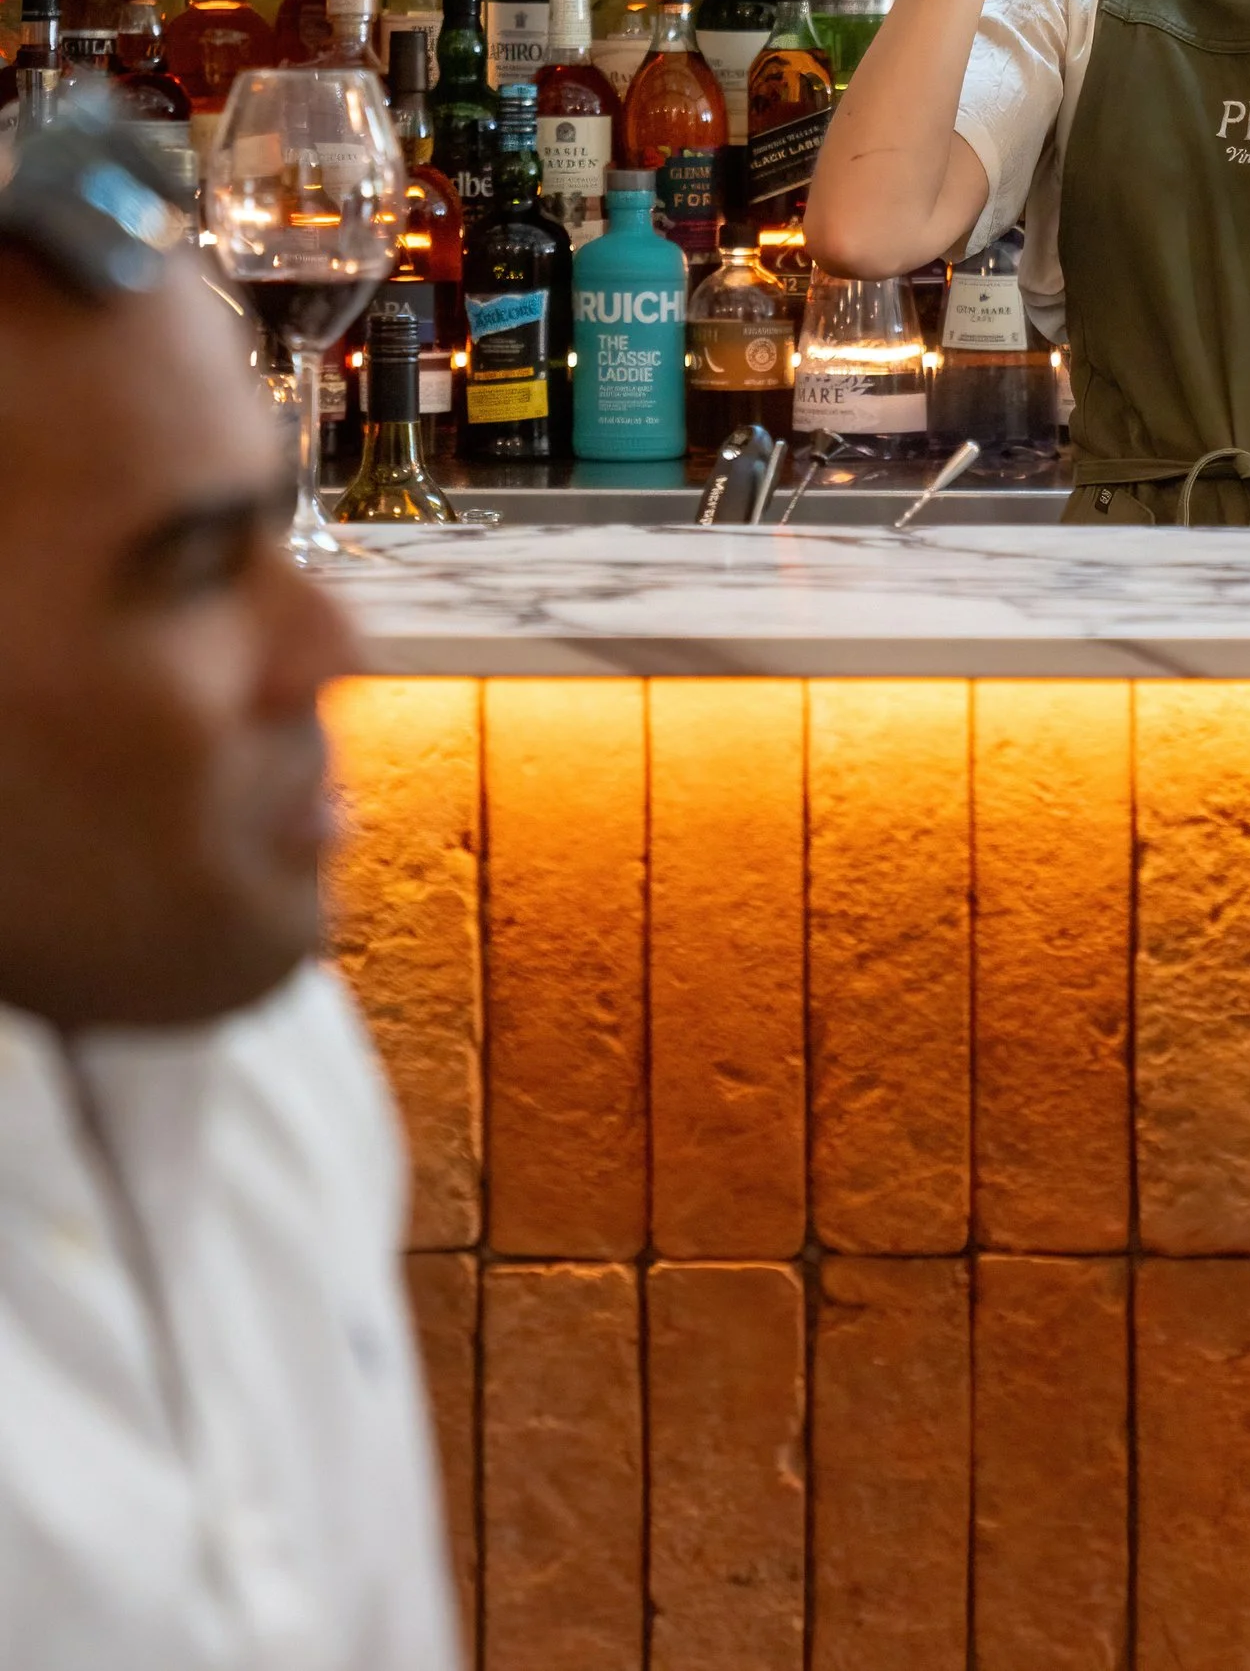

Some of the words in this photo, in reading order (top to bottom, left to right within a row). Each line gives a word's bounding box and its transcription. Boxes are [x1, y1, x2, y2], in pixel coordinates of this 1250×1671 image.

[544, 146, 588, 157] BASIL
[547, 158, 599, 169] AYDEN
[598, 334, 629, 350] THE
[598, 350, 662, 366] CLASSIC
[598, 366, 654, 382] LADDIE
